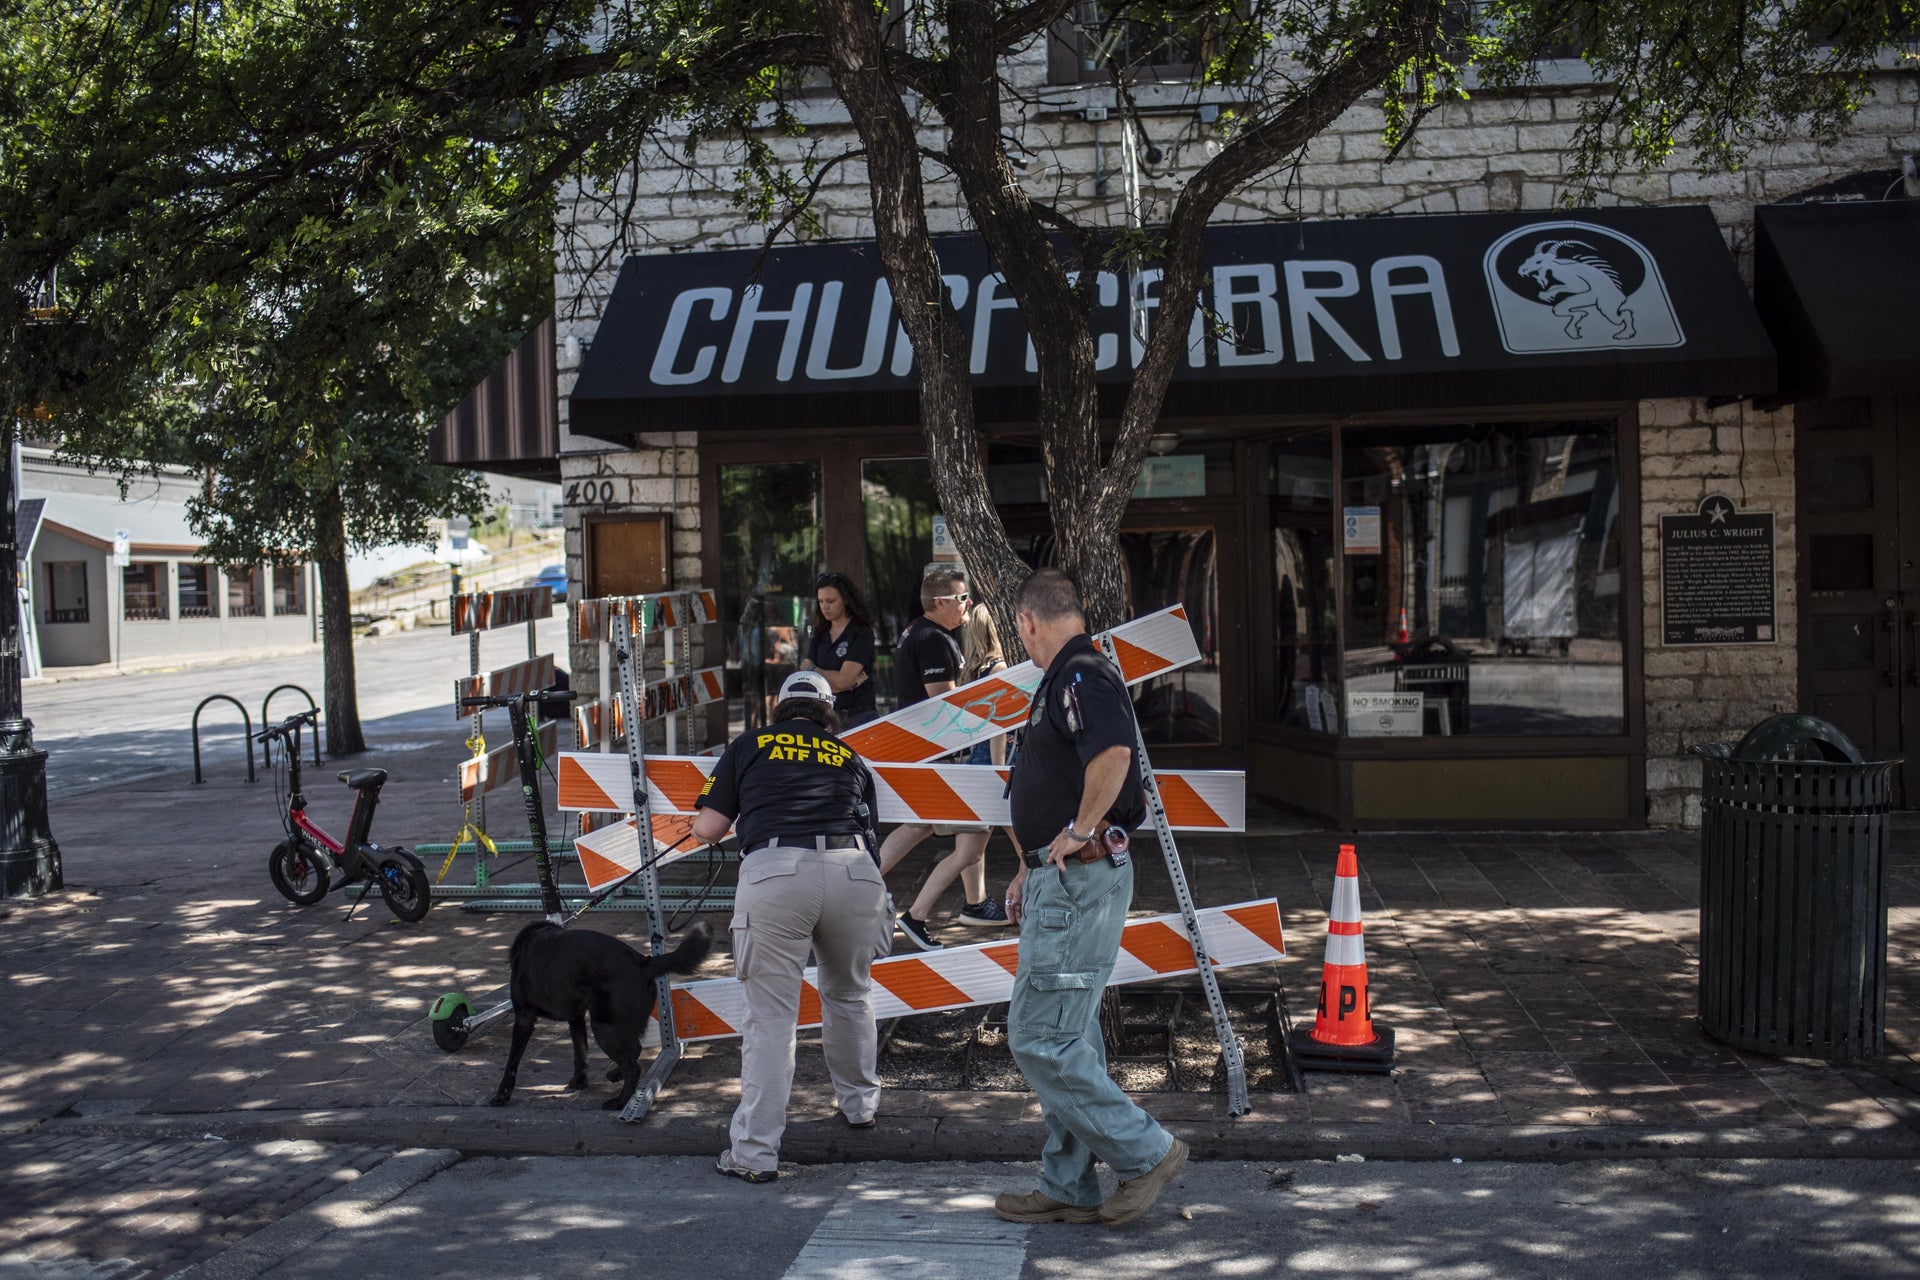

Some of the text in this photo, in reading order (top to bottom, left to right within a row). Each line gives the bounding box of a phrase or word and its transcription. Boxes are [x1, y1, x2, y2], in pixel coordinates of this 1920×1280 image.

[566, 480, 614, 504] 400
[1671, 528, 1765, 539] JULIUS C. WRIGHT
[1353, 698, 1419, 707] NO SMOKING
[757, 733, 852, 761] POLICE
[768, 746, 845, 768] ATF K9
[302, 828, 330, 855] WHEELS
